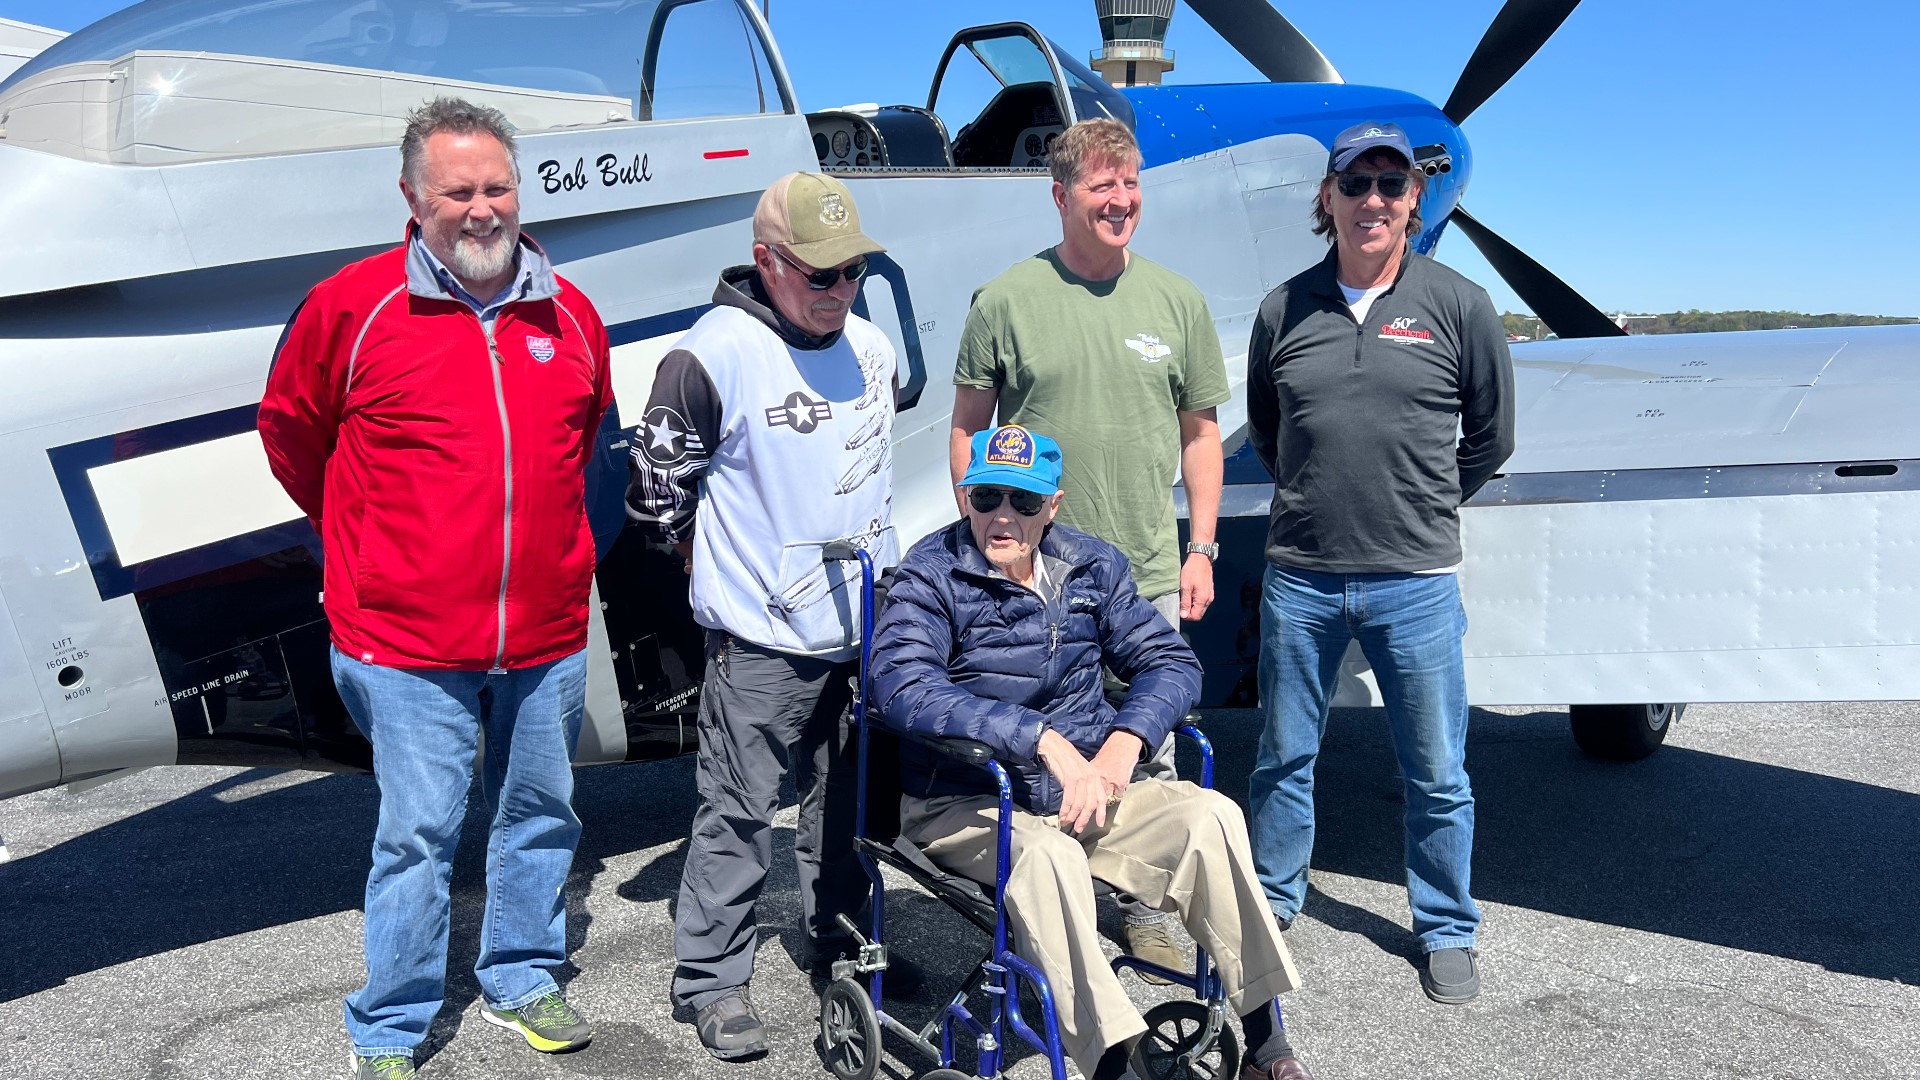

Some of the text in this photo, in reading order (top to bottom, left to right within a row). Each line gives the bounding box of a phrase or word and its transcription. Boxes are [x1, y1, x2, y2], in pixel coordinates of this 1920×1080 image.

[538, 152, 653, 195] Bob Bull
[918, 320, 936, 334] STEP
[989, 453, 1020, 462] ATLANTA
[52, 637, 73, 650] LIFT
[55, 646, 77, 657] CAUTION
[46, 649, 90, 670] 1600 LBS
[64, 686, 92, 702] MOOR
[154, 669, 250, 707] AIR SPEED LINE DRAIN
[655, 686, 698, 712] AFTERCOOLANT
[669, 699, 688, 712] DRAIN
